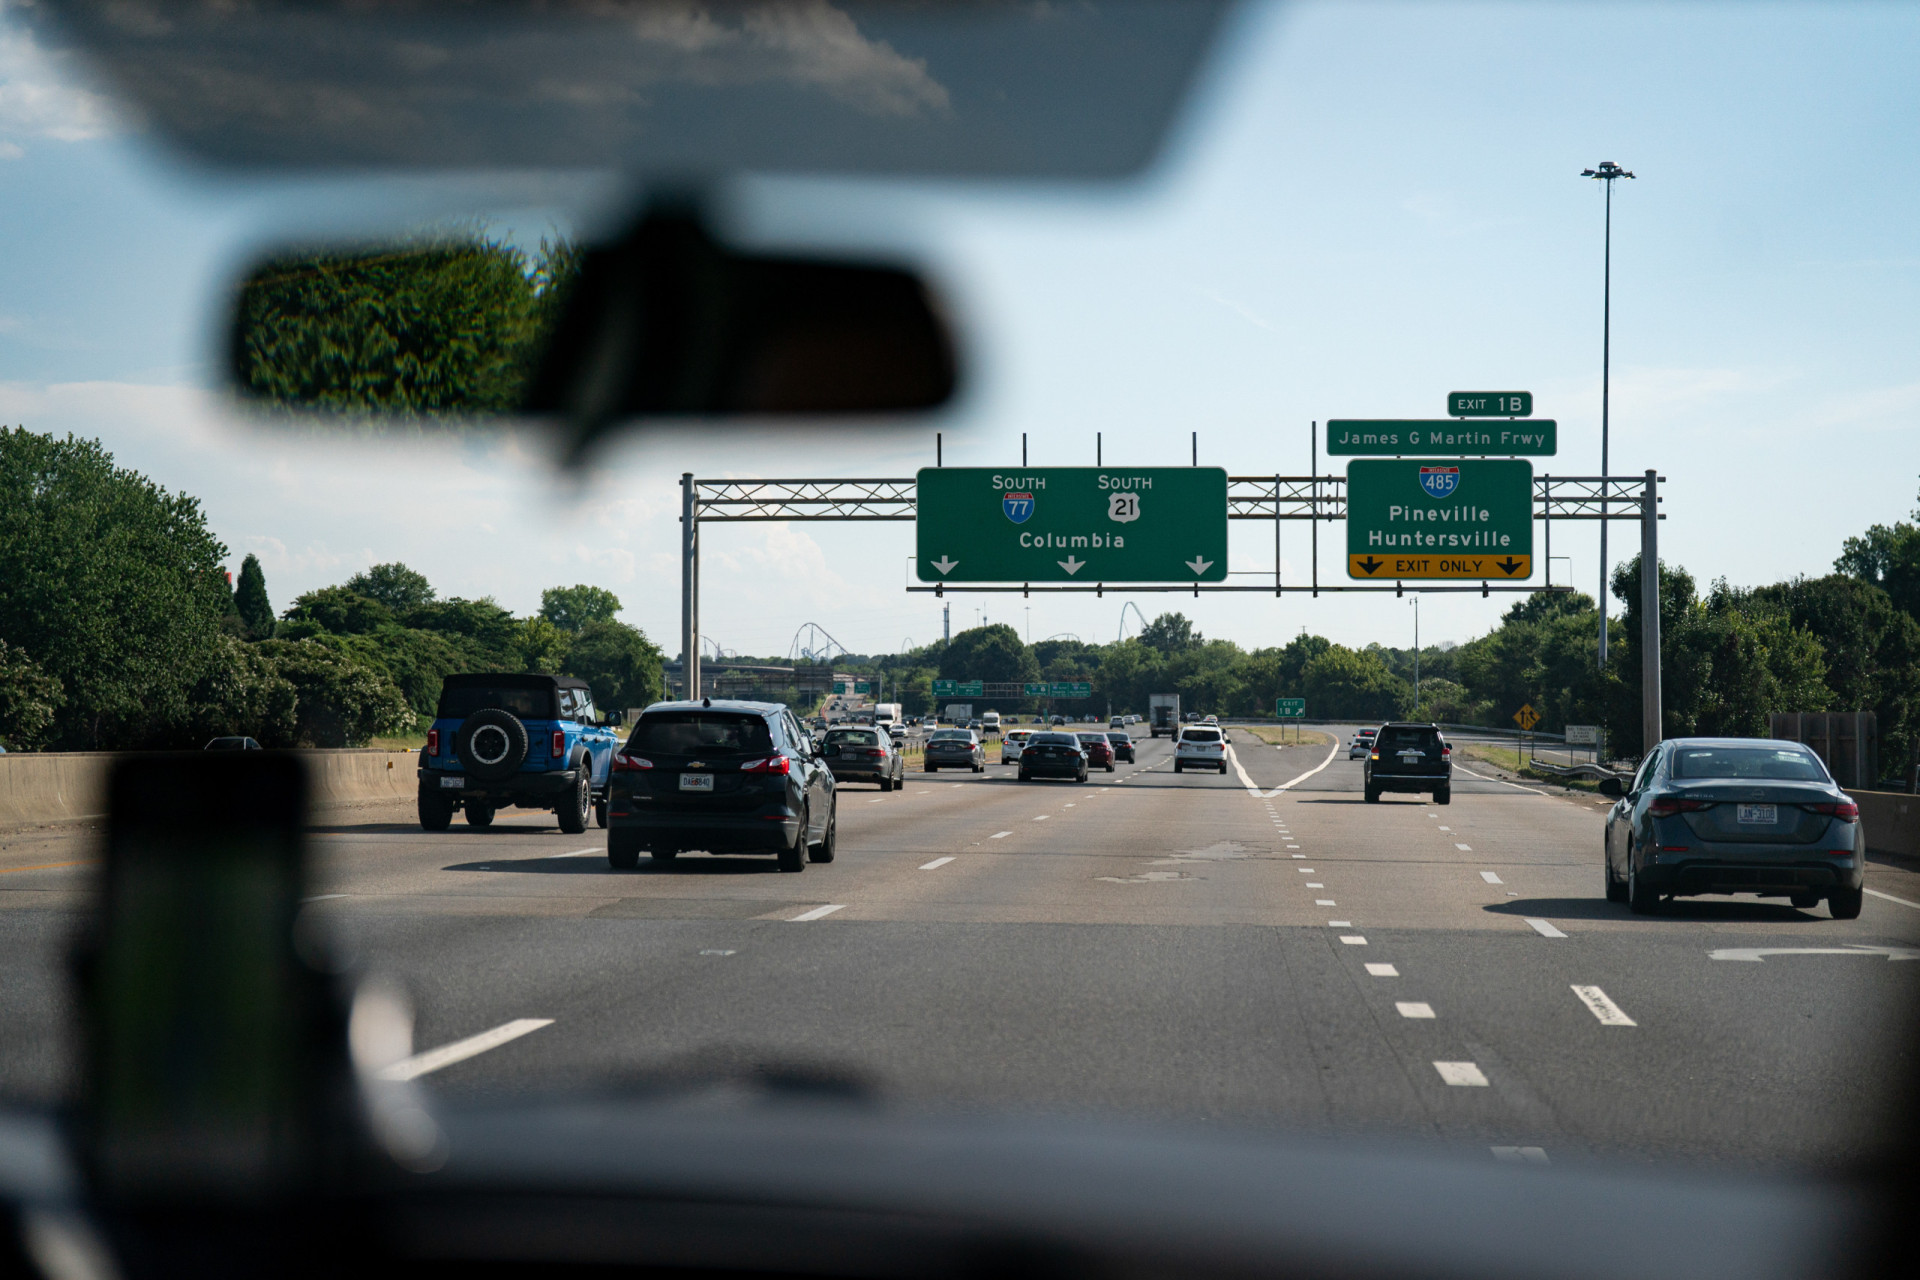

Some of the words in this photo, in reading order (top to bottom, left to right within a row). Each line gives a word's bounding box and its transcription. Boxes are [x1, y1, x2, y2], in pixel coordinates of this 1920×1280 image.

[1457, 399, 1487, 410] EXIT
[1338, 431, 1399, 445] James
[1409, 432, 1420, 445] G
[1430, 431, 1491, 445] Martin
[1500, 431, 1546, 448] Frwy
[1425, 474, 1454, 490] 485
[1008, 501, 1030, 516] 77
[1114, 499, 1134, 516] 21
[1389, 505, 1491, 522] Pineville
[1019, 532, 1125, 548] Columbia
[1368, 530, 1511, 546] Huntersville
[1396, 560, 1430, 572] EXIT
[1440, 560, 1484, 573] ONLY
